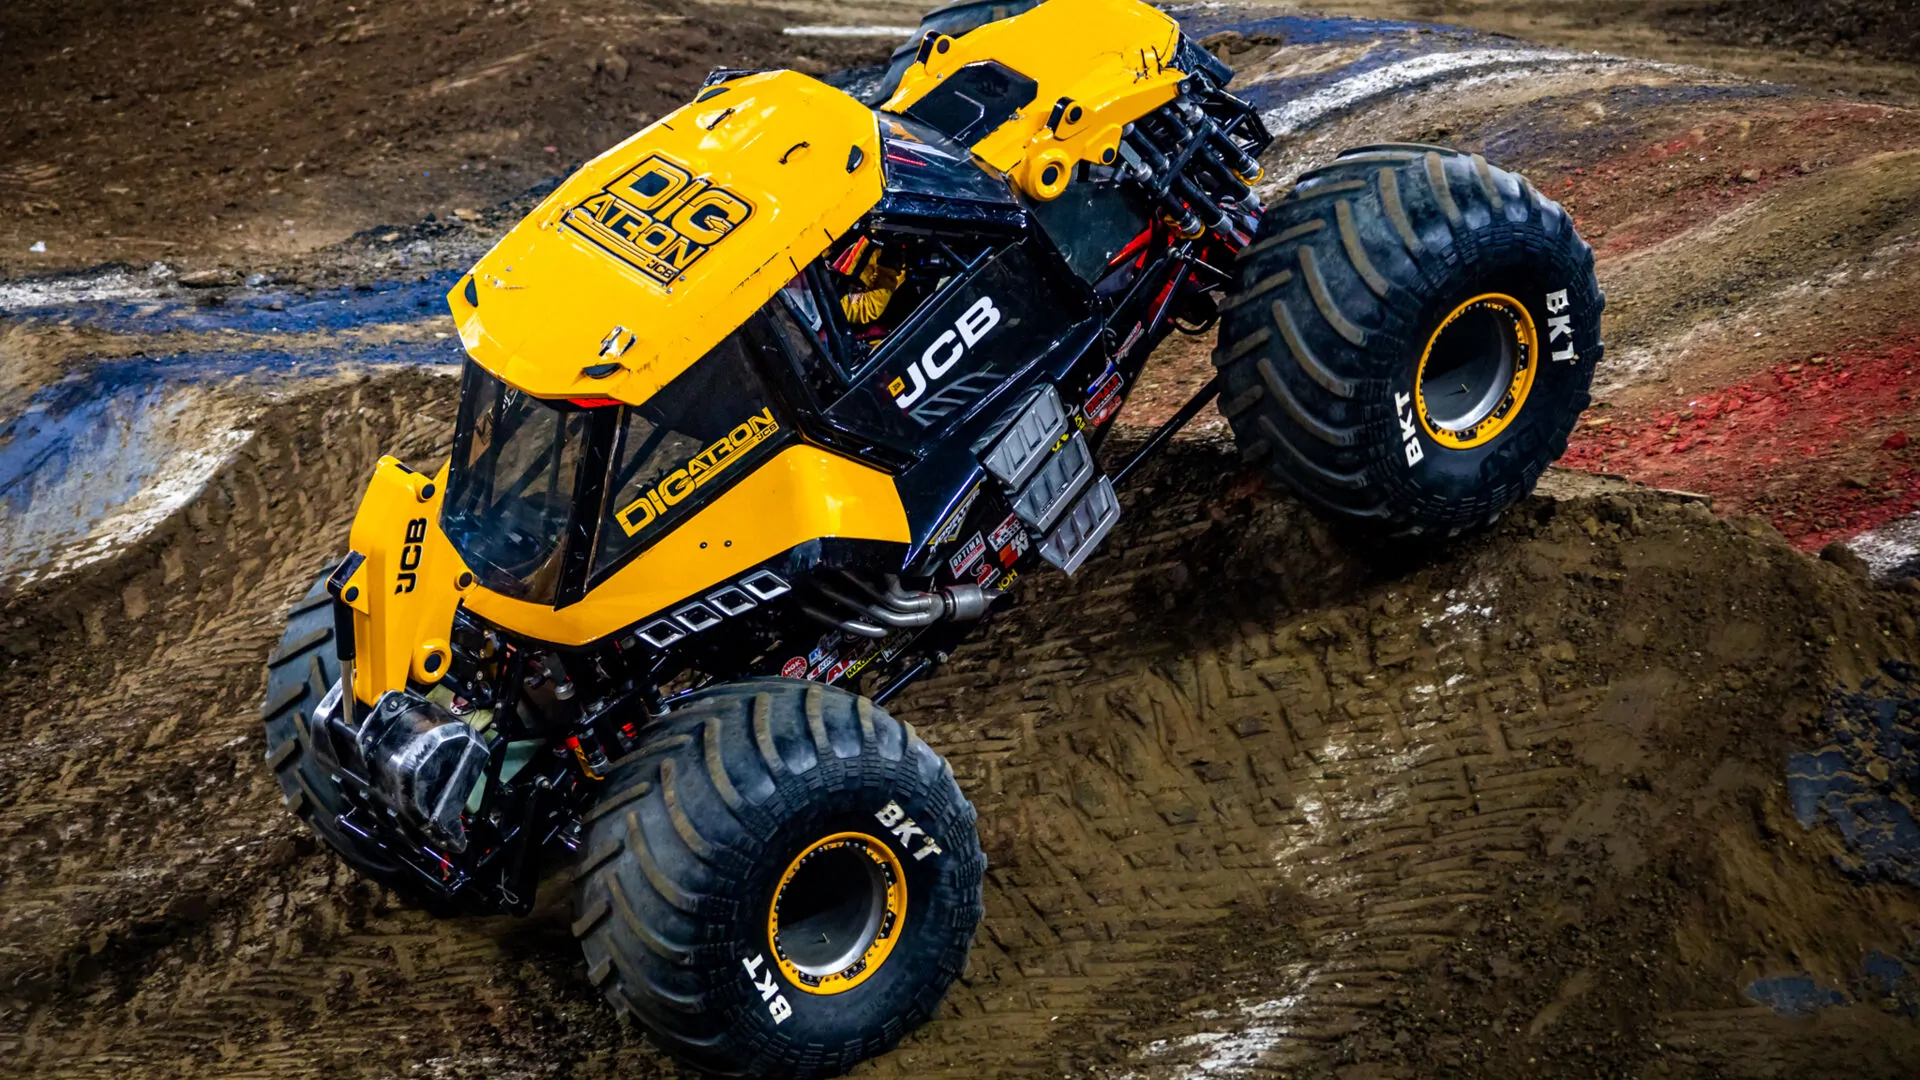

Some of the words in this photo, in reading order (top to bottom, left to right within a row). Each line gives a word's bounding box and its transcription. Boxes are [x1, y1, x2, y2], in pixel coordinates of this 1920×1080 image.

[583, 193, 707, 268] ATRON
[603, 155, 750, 246] DIG
[646, 259, 674, 279] JCB
[895, 296, 1000, 409] JCB
[1546, 288, 1579, 366] BKT
[756, 423, 779, 441] JCB
[1394, 391, 1424, 468] BKT
[615, 406, 775, 538] DIGATRON
[394, 517, 428, 595] JCB
[952, 536, 982, 567] OPTIMA
[874, 799, 943, 861] BKT
[742, 953, 793, 1025] BKT
